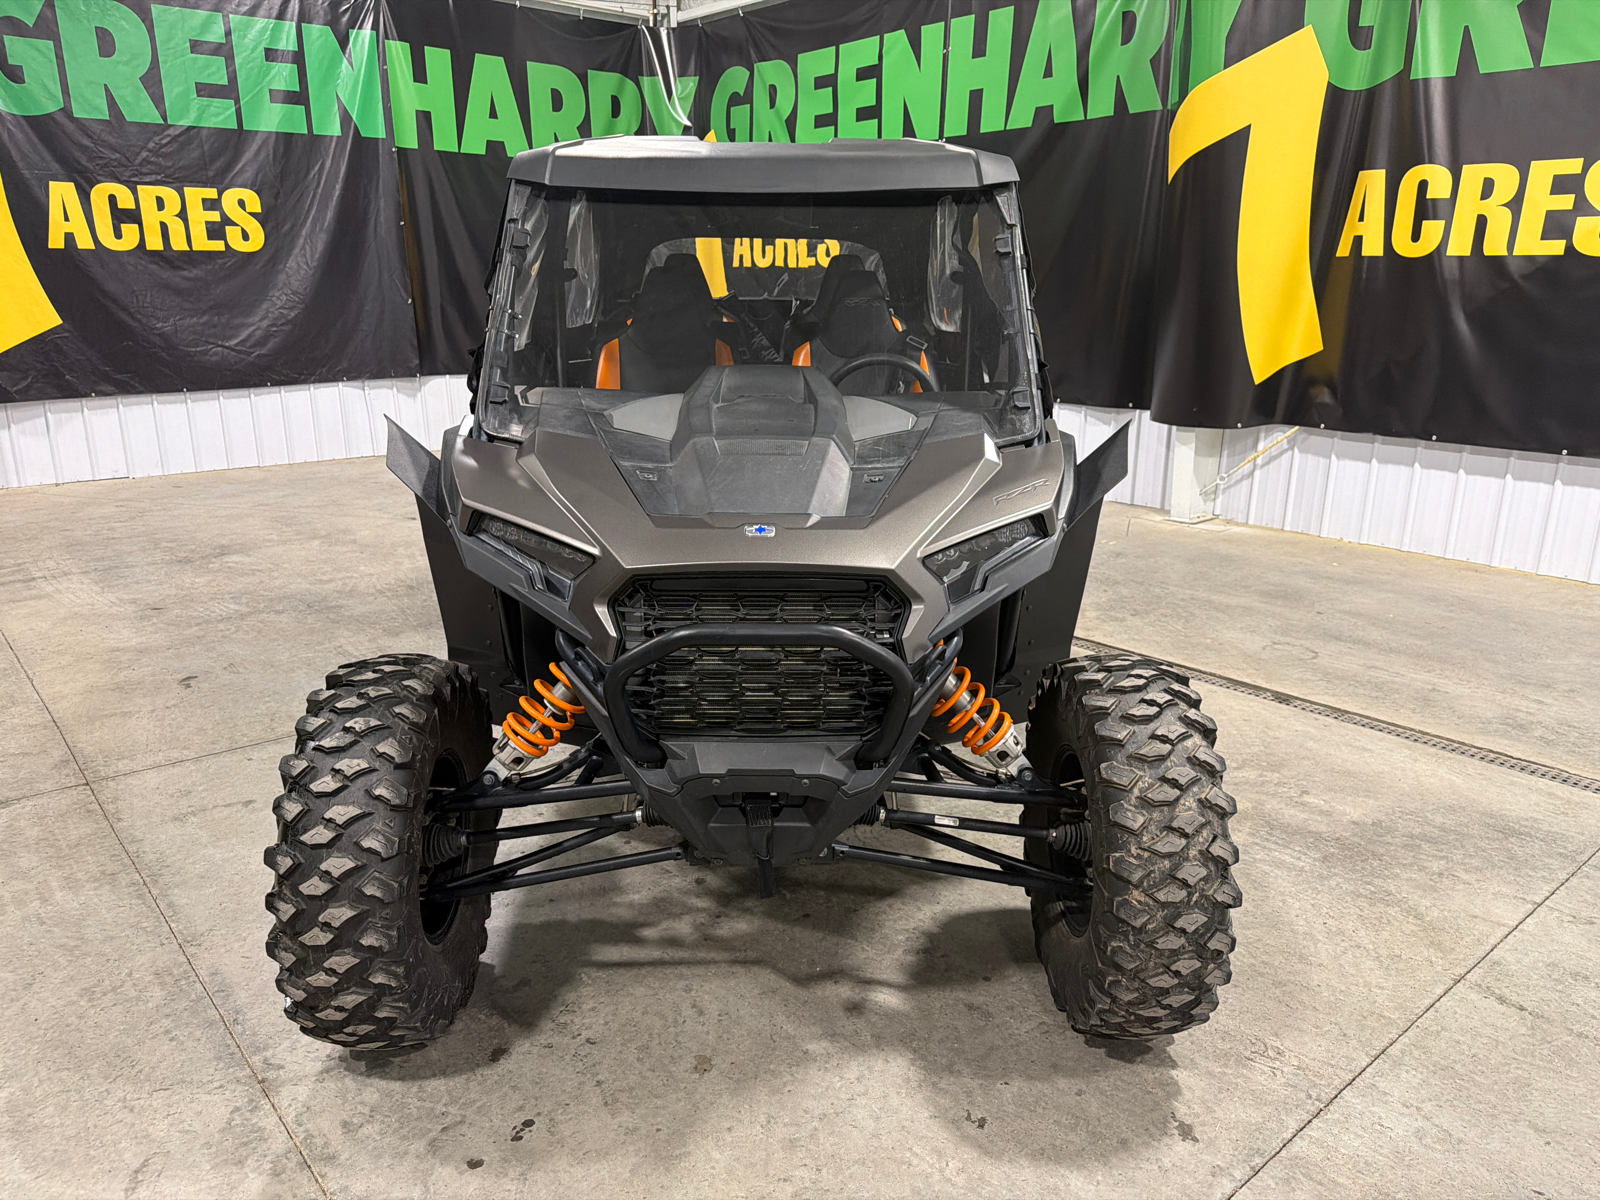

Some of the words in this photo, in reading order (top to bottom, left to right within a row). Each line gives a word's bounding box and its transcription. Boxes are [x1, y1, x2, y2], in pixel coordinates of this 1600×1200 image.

[0, 0, 386, 139] GREEN
[385, 40, 699, 157] HARRY
[710, 22, 945, 143] GREEN
[943, 0, 1242, 137] HAR
[47, 181, 266, 253] ACRES
[1168, 24, 1329, 385] 7
